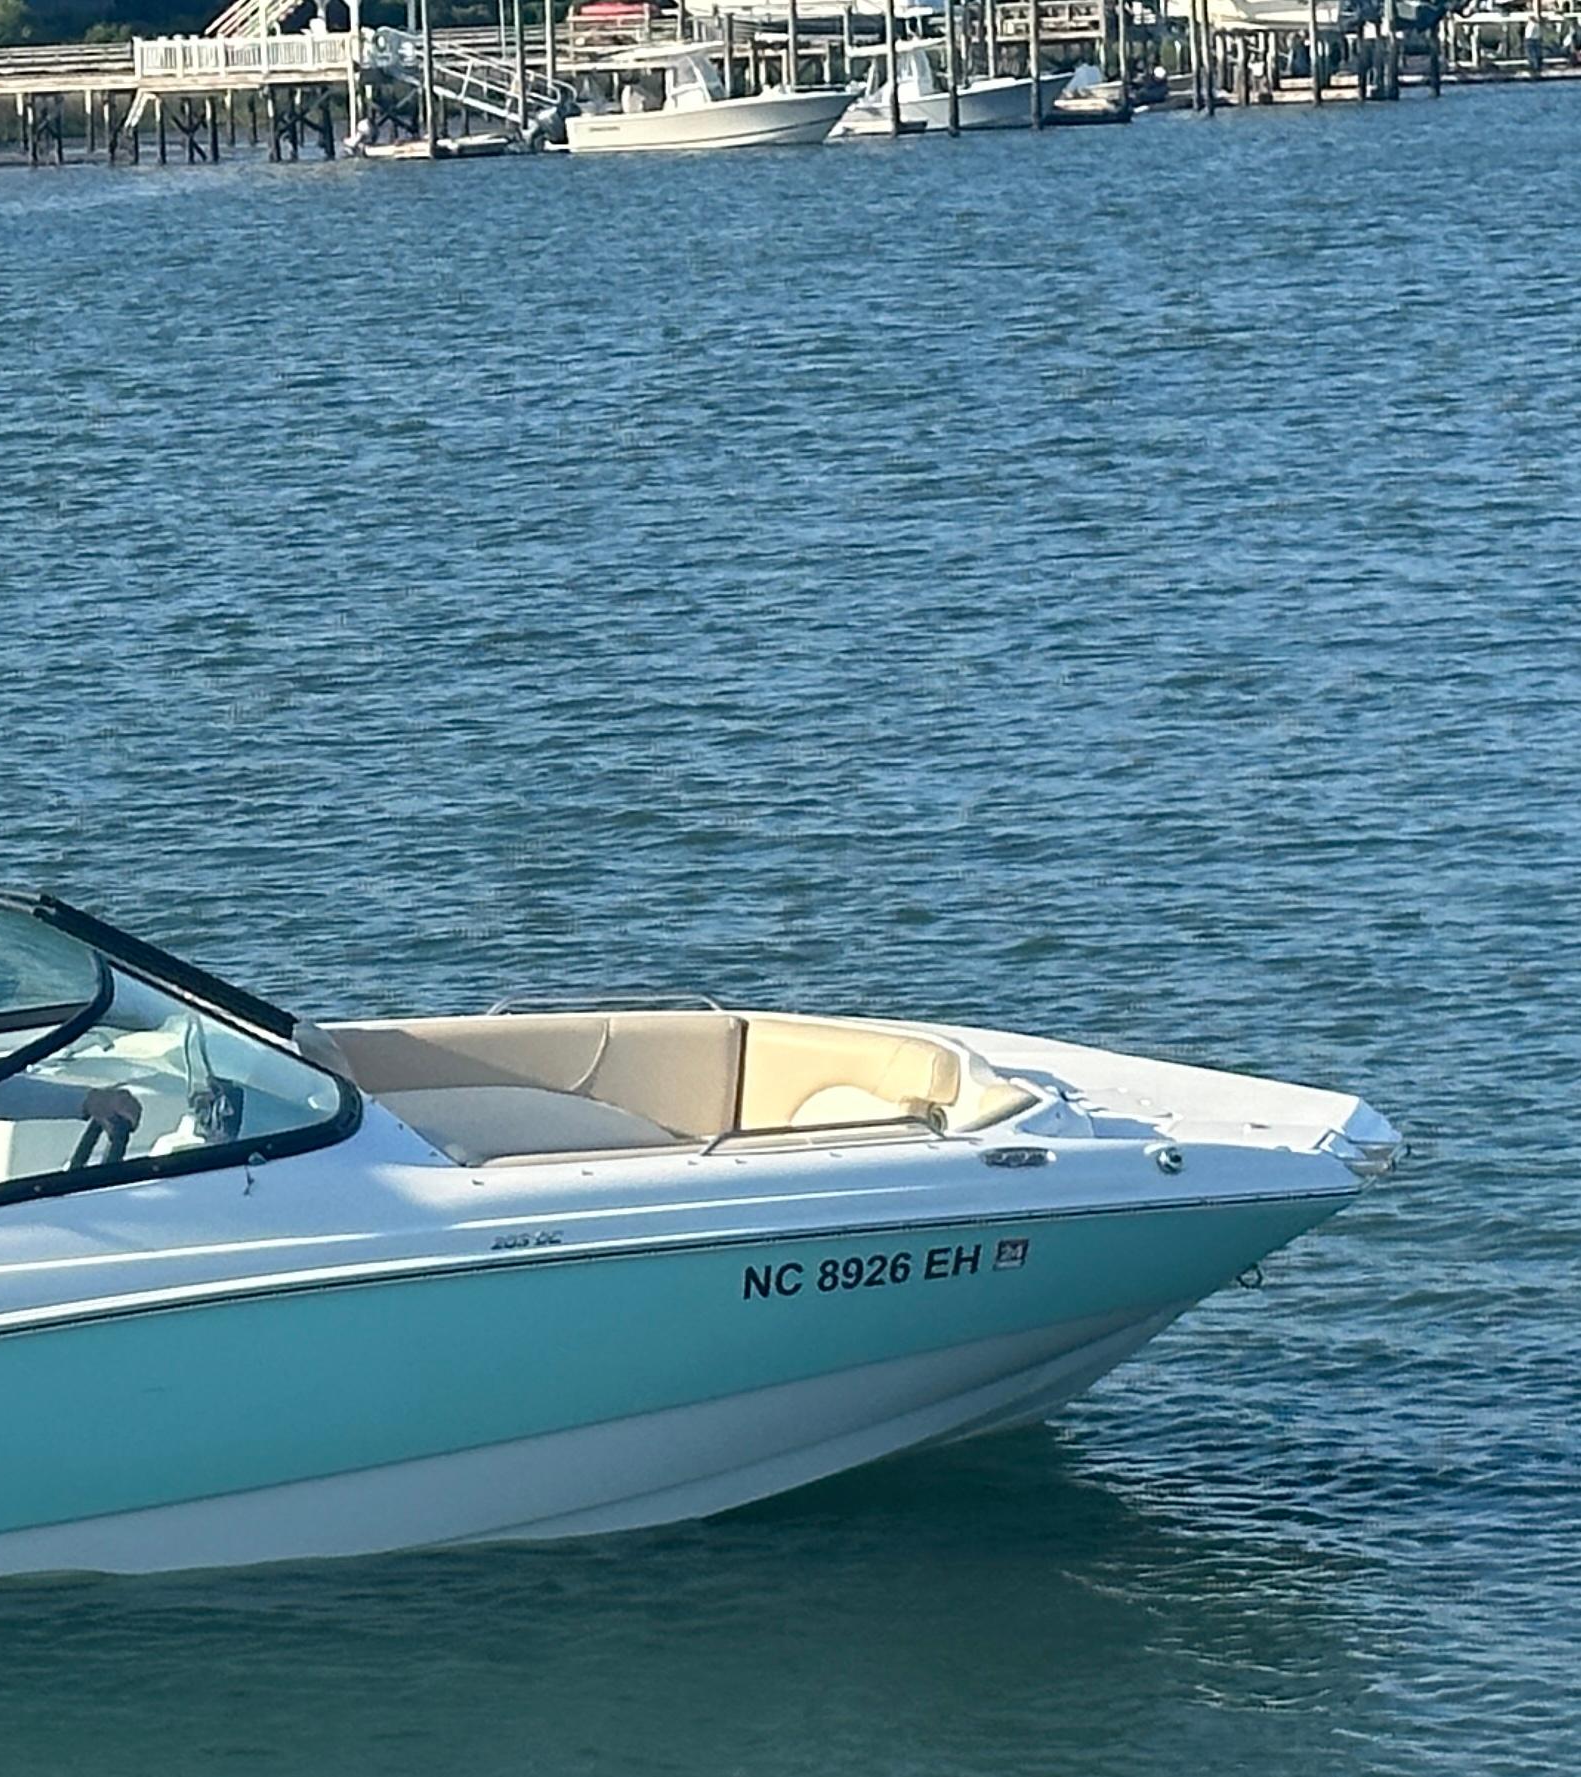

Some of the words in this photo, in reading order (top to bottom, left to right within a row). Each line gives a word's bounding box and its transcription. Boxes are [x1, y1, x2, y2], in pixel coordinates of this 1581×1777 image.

[743, 1262, 805, 1300] NC
[816, 1251, 913, 1293] 8926
[923, 1243, 982, 1281] EH
